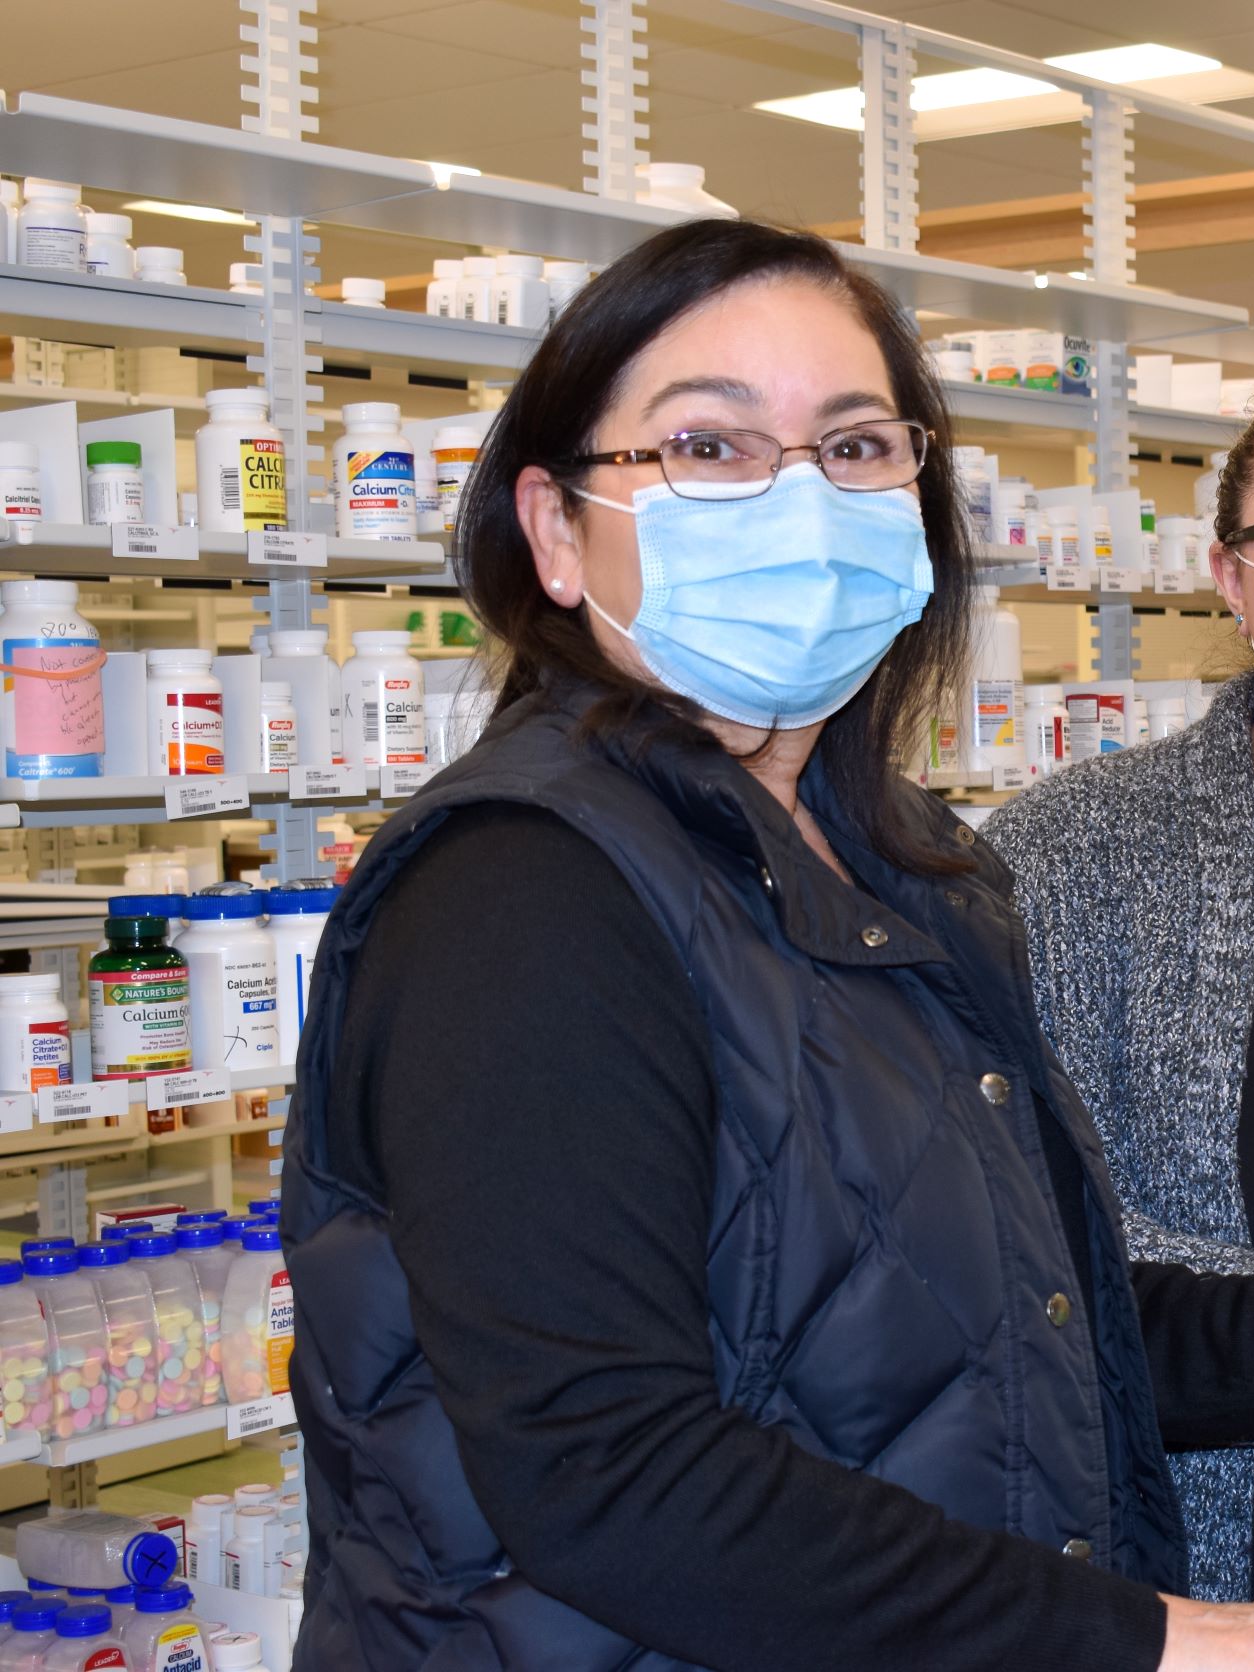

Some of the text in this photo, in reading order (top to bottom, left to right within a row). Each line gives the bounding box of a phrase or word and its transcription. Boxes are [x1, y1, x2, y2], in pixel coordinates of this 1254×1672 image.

[353, 483, 398, 496] Calcium
[131, 972, 168, 981] Compare
[227, 979, 263, 990] Calcium
[250, 1002, 263, 1011] 667
[123, 1009, 178, 1023] Calcium
[33, 1038, 62, 1046] Calcium
[33, 1054, 59, 1062] Petites
[164, 1657, 201, 1672] Antacid
